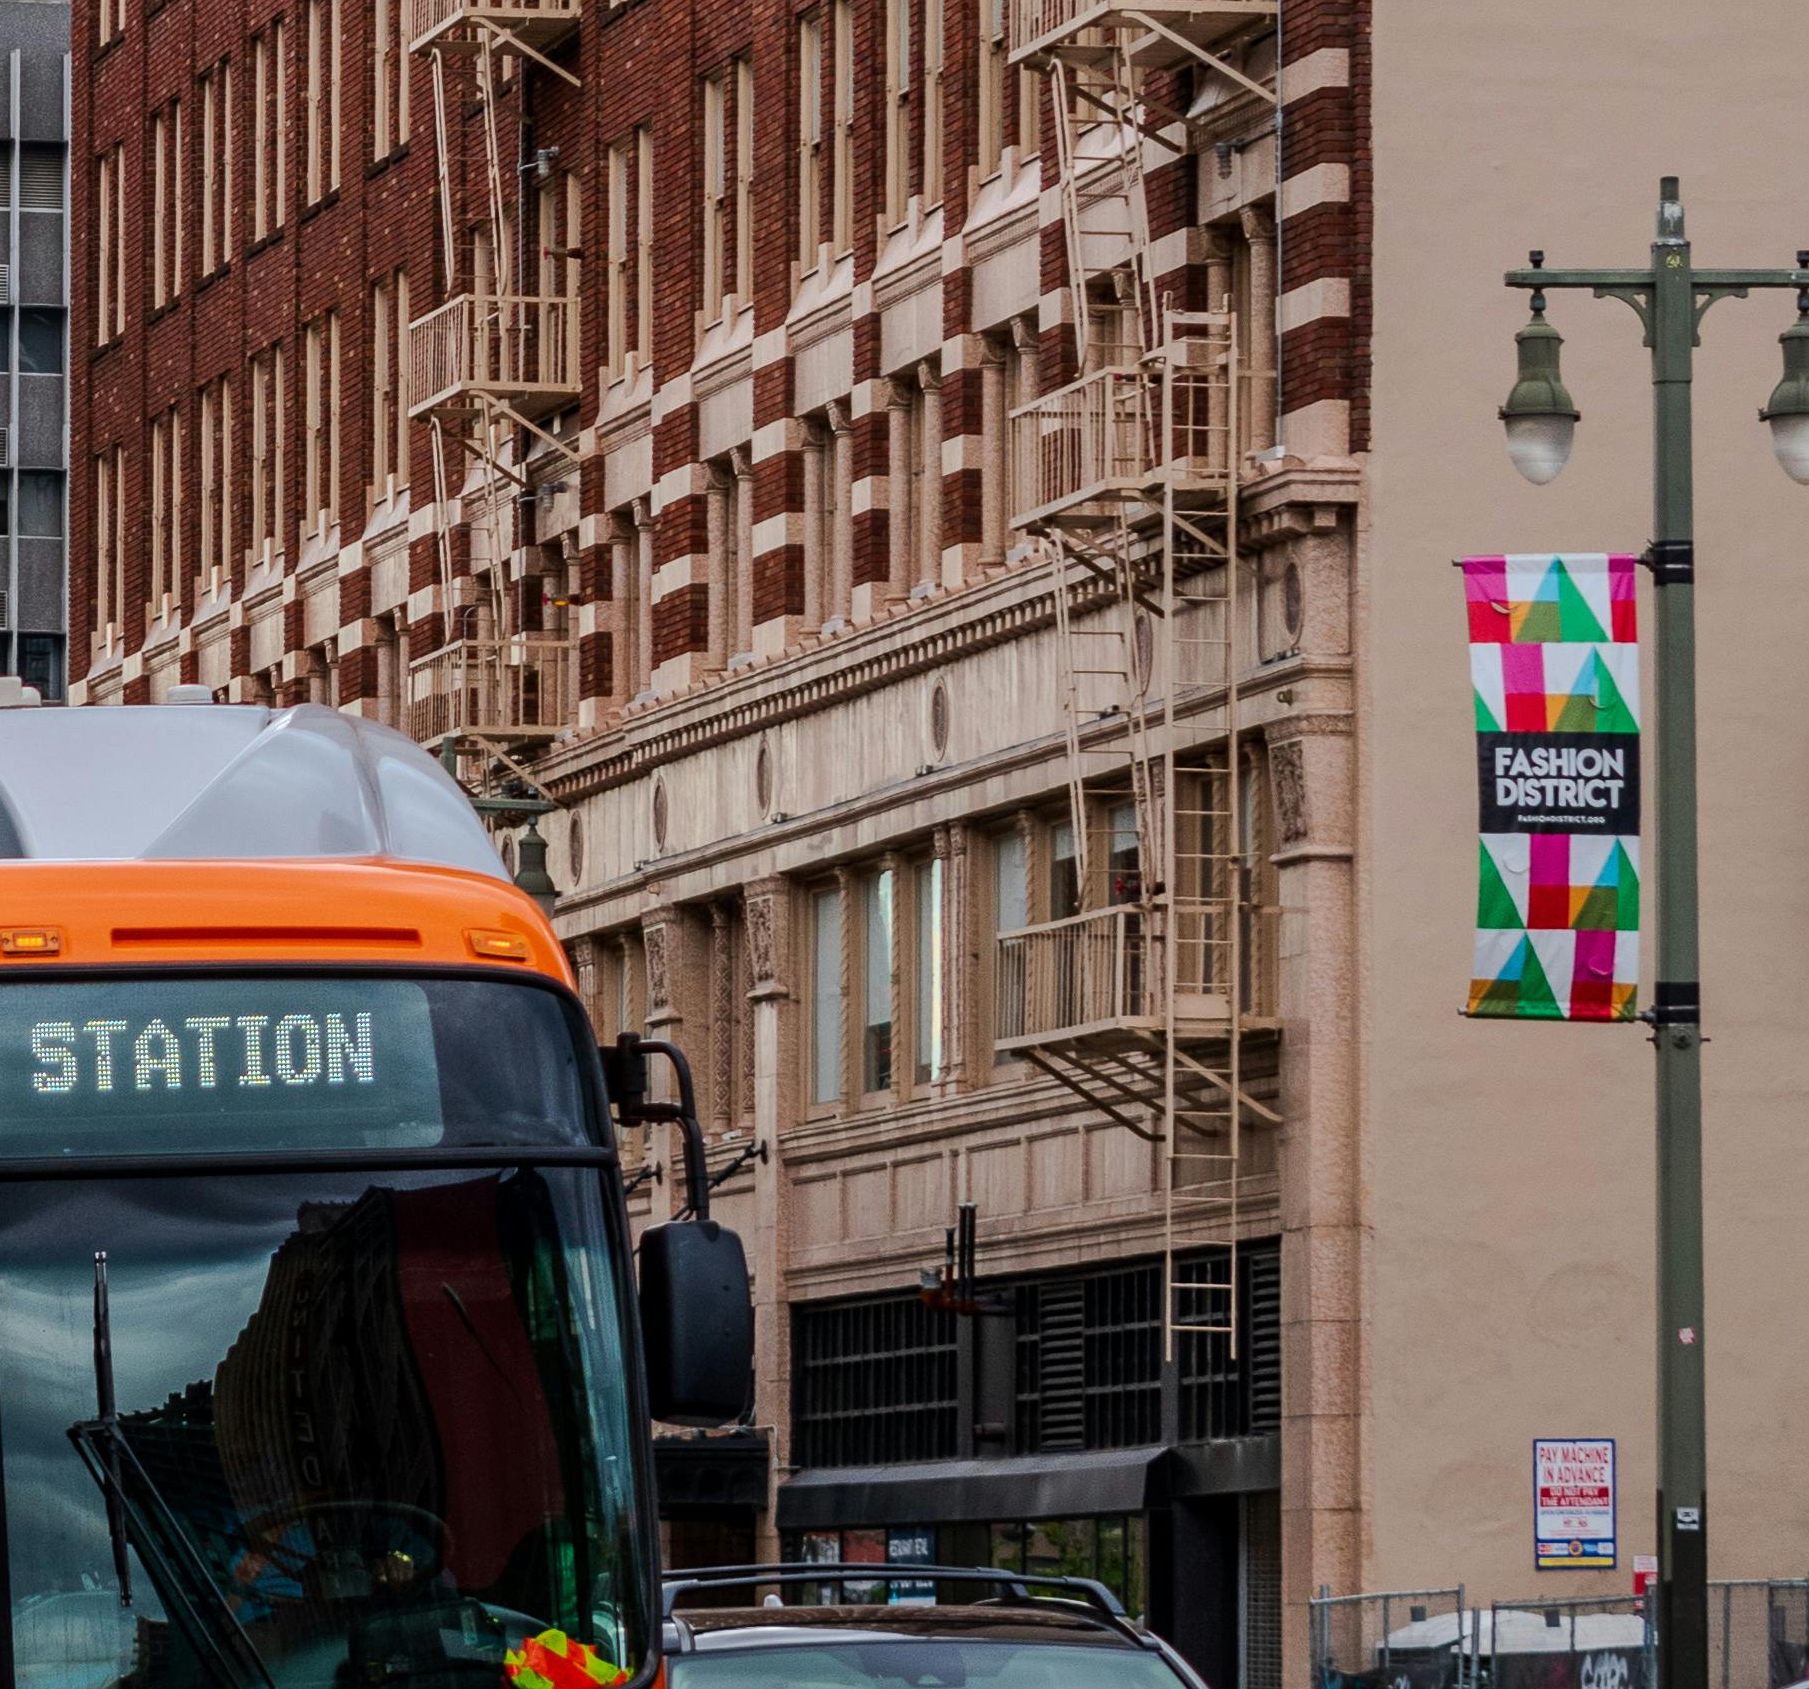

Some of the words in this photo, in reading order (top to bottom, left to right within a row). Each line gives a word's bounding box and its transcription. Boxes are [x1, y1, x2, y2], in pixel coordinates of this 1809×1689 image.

[1495, 747, 1624, 777] FASHION
[1496, 778, 1625, 808] DISTRICT
[1518, 814, 1606, 824] FASHIONDISTRICT.ORG
[31, 1012, 374, 1092] STATION
[1540, 1446, 1557, 1463] PAY
[1561, 1446, 1609, 1464] MACHINE
[1544, 1466, 1554, 1482] IN
[1557, 1466, 1605, 1483] ADVANCE
